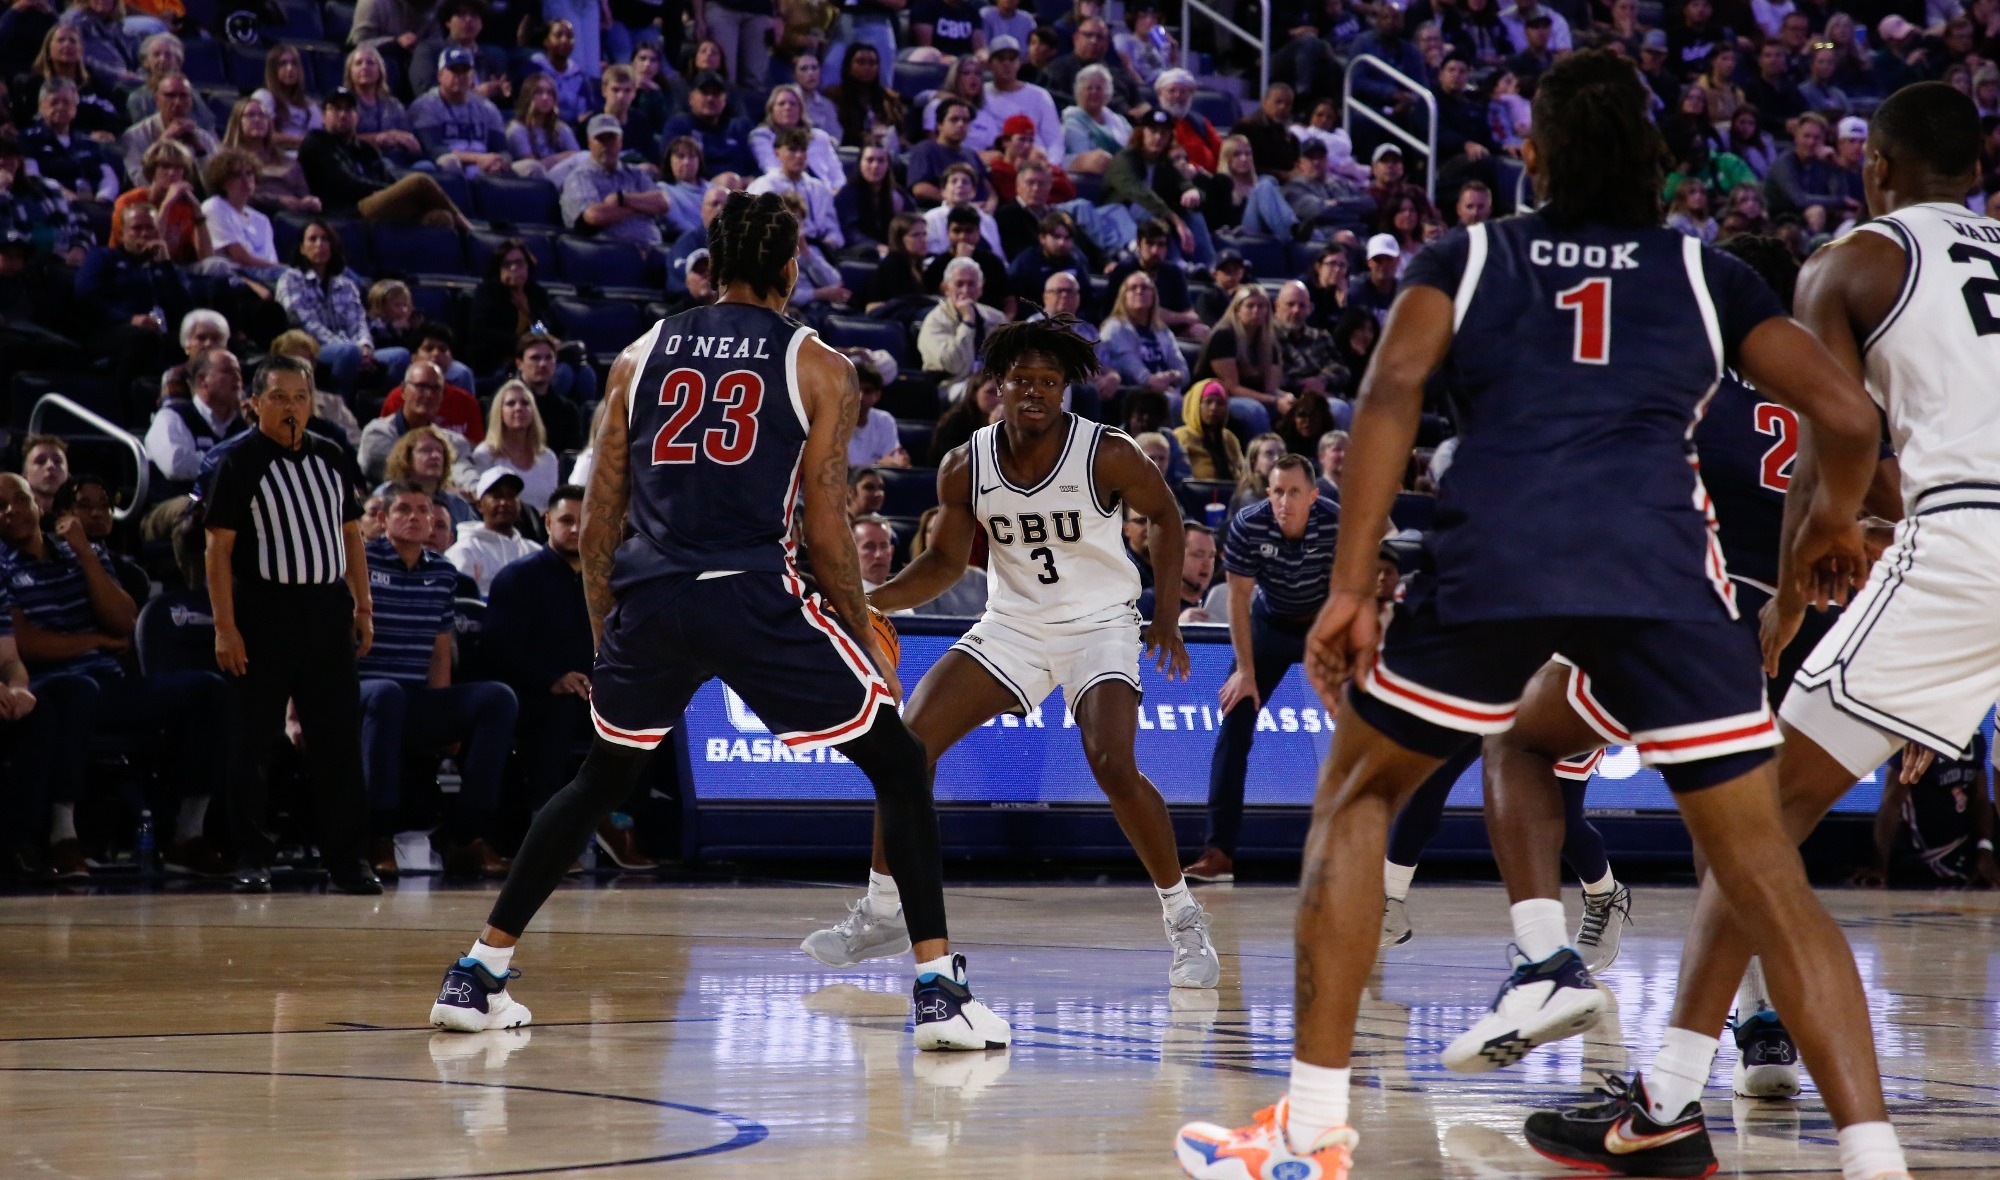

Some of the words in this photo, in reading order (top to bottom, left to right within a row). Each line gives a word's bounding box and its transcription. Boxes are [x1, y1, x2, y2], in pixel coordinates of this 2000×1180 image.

[1944, 219, 2000, 244] WAD
[1530, 239, 1640, 270] COOK
[1555, 277, 1612, 365] 1
[665, 334, 770, 360] O'NEAL
[651, 367, 765, 466] 23
[987, 509, 1082, 546] CBU
[1030, 547, 1059, 584] 3
